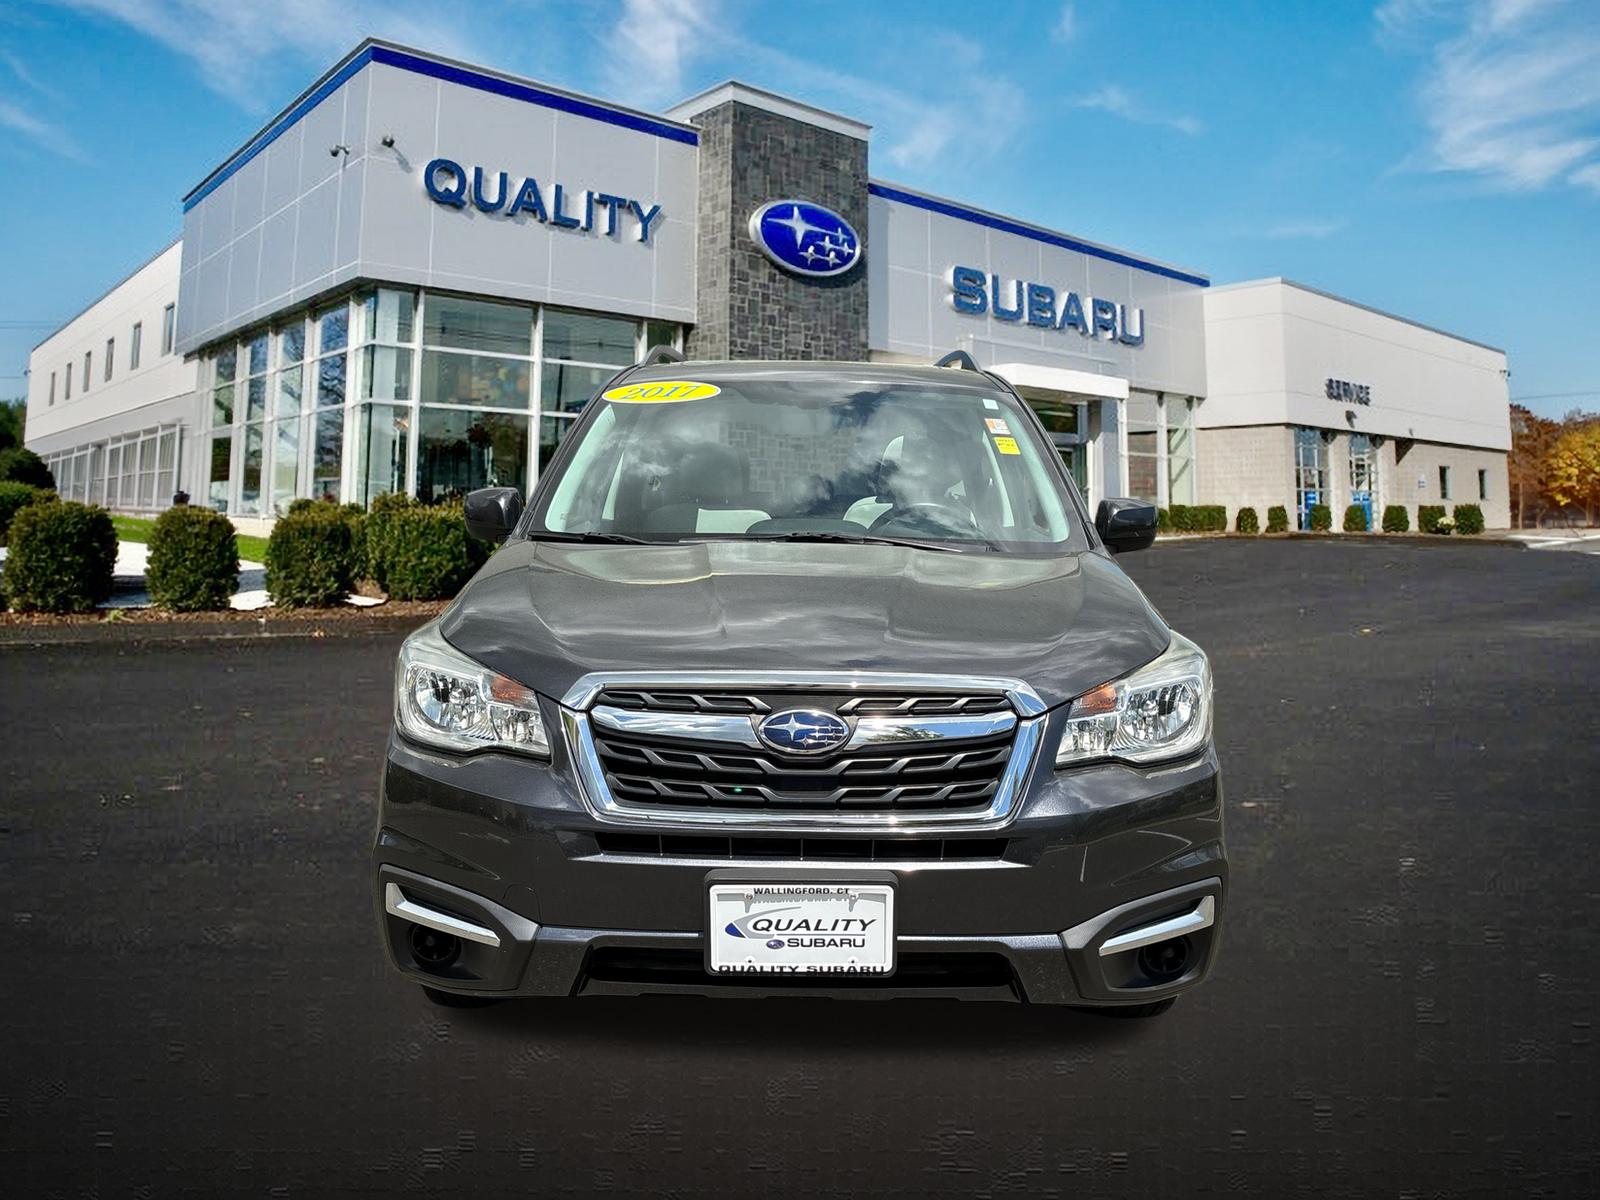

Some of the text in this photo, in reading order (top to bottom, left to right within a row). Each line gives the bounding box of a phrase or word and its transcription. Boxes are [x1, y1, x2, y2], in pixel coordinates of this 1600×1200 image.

[424, 158, 661, 243] QUALITY
[951, 265, 1145, 346] SUBARU
[620, 385, 701, 400] 2017
[836, 887, 850, 895] CT
[752, 918, 877, 932] QUALITY
[787, 938, 866, 948] SUBARU
[718, 965, 884, 973] QUALITY SUBARU
